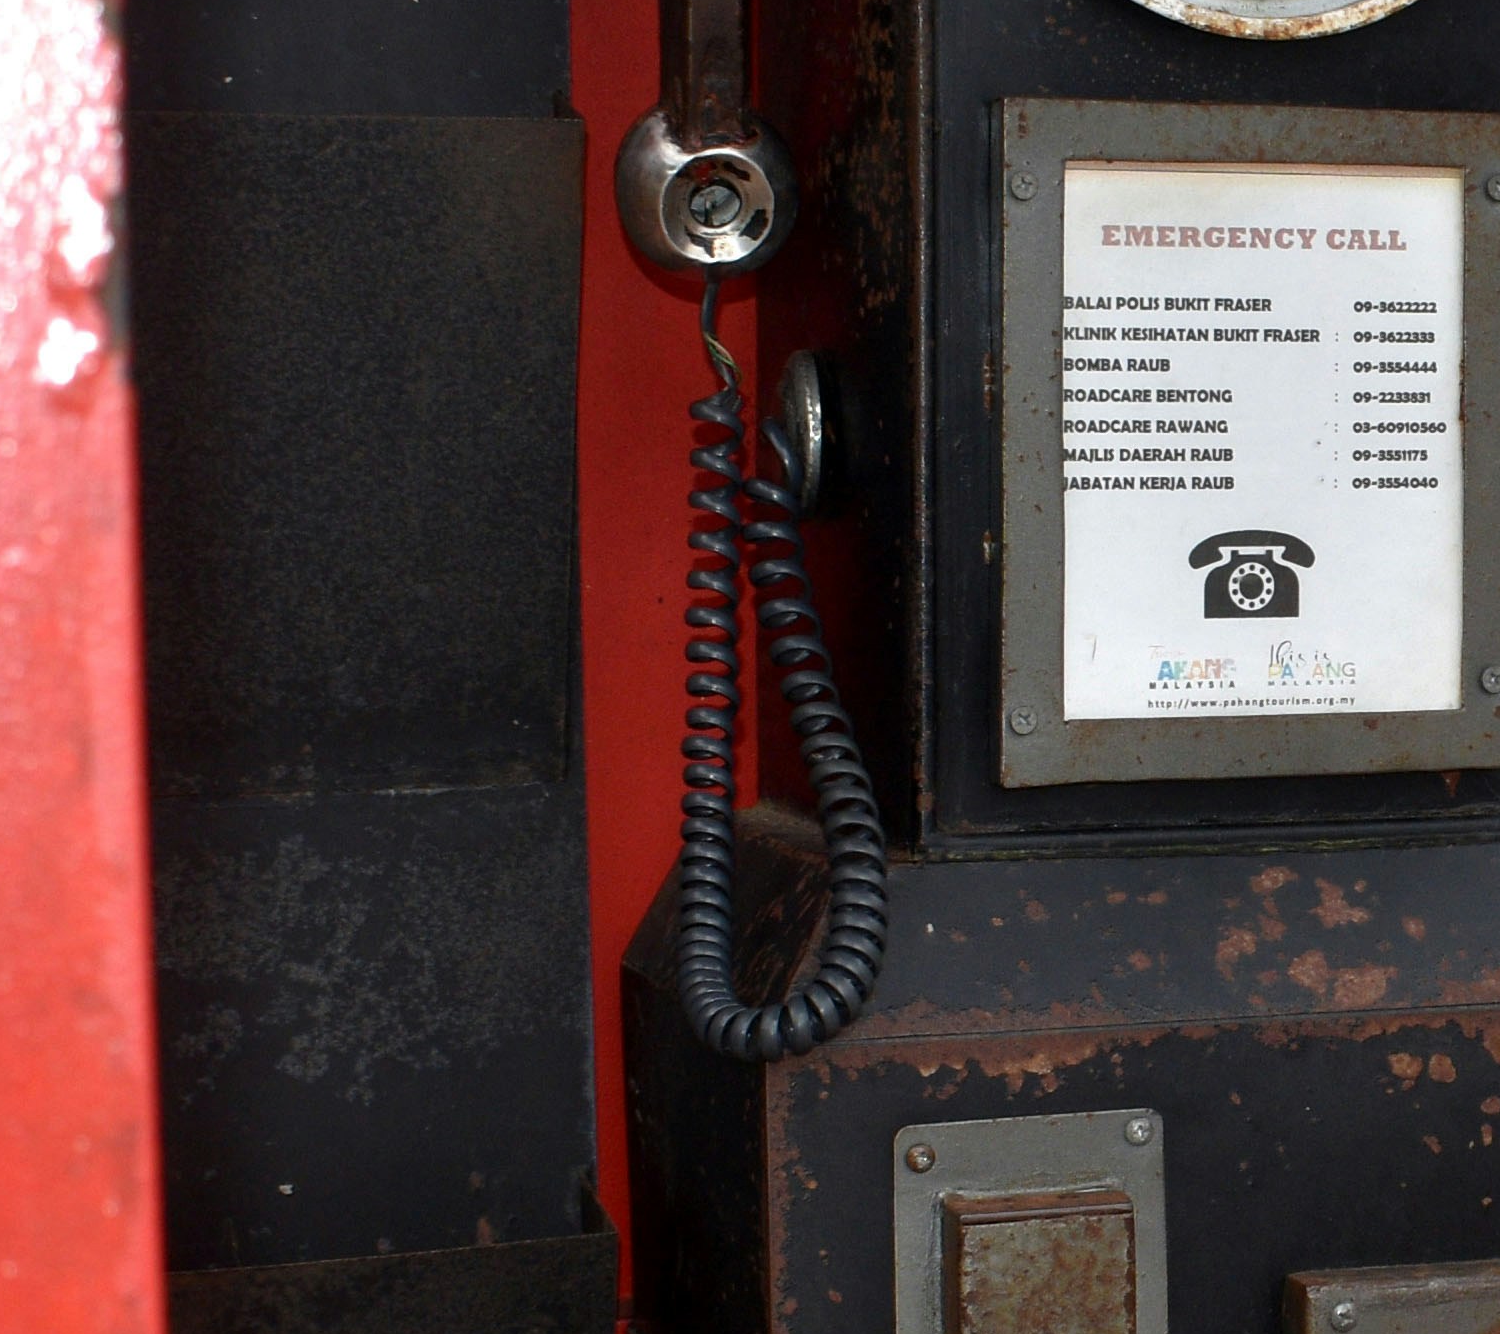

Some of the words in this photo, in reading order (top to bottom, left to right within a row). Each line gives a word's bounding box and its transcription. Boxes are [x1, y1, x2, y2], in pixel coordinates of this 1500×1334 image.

[1102, 225, 1317, 249] EMERGENCY
[1326, 228, 1407, 250] CALL
[1064, 296, 1112, 310] BALAI
[1116, 297, 1160, 310] POLIS
[1164, 297, 1210, 311] BUKIT
[1214, 298, 1271, 311] FRASER
[1354, 301, 1437, 313] 09-3622222
[1064, 327, 1117, 341] KLINIK
[1121, 327, 1209, 341] KESIHATAN
[1214, 328, 1259, 342] BUKIT
[1263, 329, 1320, 342] FRASER
[1353, 331, 1435, 343] 09-3622333
[1064, 358, 1123, 371] BOMBA
[1127, 358, 1170, 372] RAUB
[1353, 361, 1437, 373] 09-3554444
[1064, 389, 1152, 402] ROADCARE
[1156, 389, 1232, 403] BENTONG
[1353, 392, 1431, 403] 09-2233831
[1064, 420, 1152, 433] ROADCARE
[1156, 420, 1228, 433] RAWANG
[1353, 422, 1447, 433] 03-60910560
[1064, 448, 1114, 463] MAJLIS
[1119, 448, 1186, 461] DAERAH
[1190, 448, 1233, 461] RAUB
[1352, 450, 1428, 461] 09-3551175
[1140, 477, 1187, 491] KERJA
[1192, 476, 1234, 490] RAUB
[1352, 477, 1438, 489] 09-3554040
[1268, 662, 1356, 678] PAANG
[1149, 680, 1236, 689] MALAYSIA
[1147, 696, 1355, 710] http://www.pahangtourism.org.my
